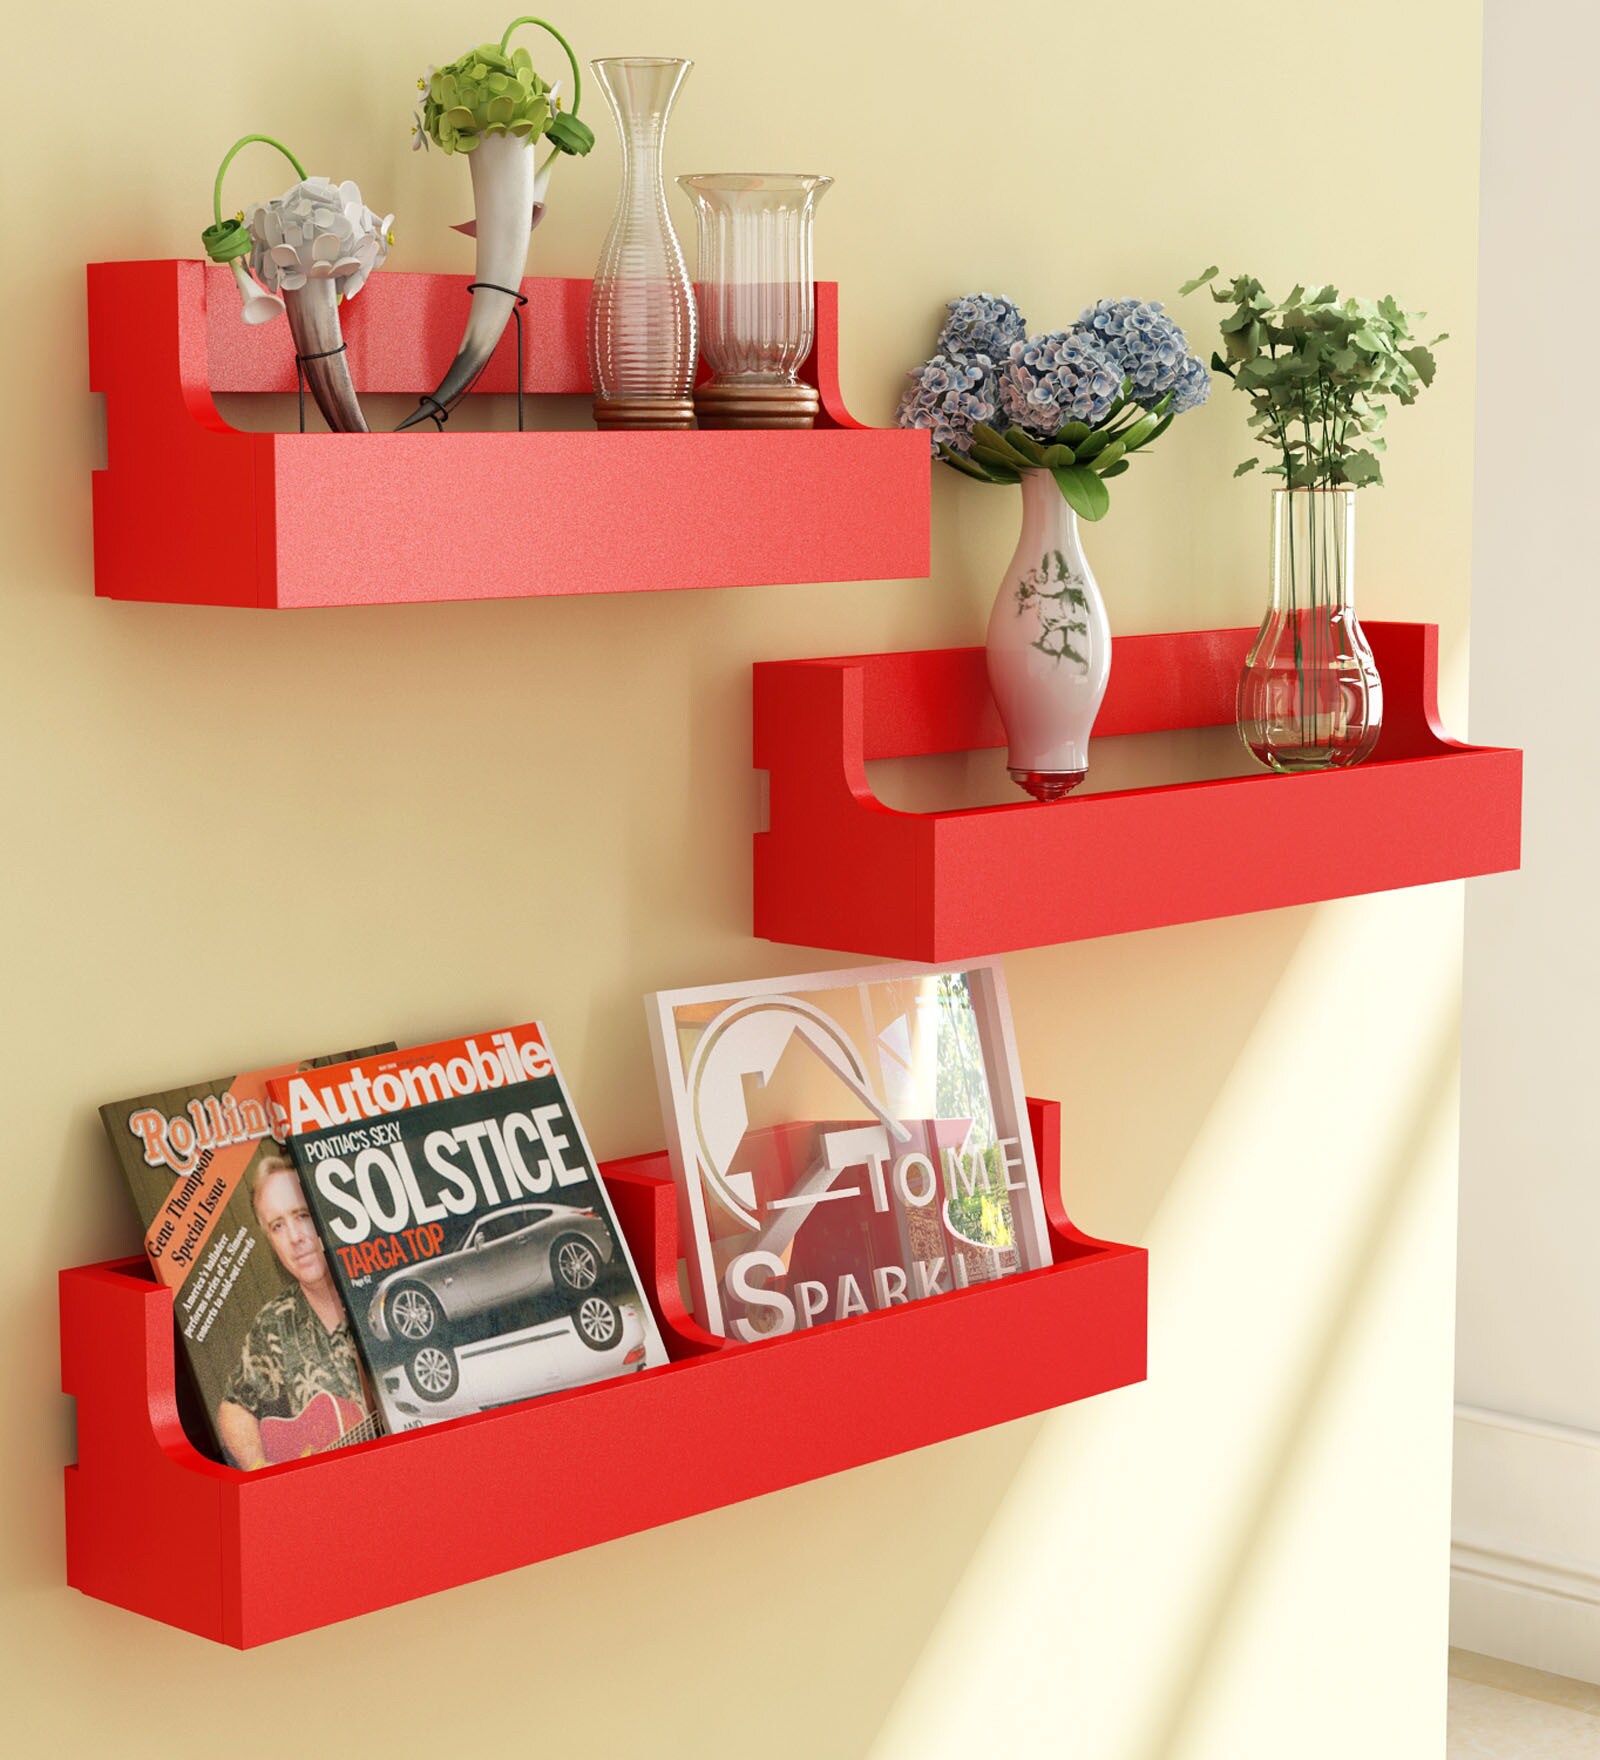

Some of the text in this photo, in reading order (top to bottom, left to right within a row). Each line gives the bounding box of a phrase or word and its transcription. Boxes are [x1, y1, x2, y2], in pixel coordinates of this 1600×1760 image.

[288, 1032, 552, 1136] Automobile
[304, 1121, 403, 1163] PONTIAC'S SEXY
[315, 1104, 588, 1244] SOLSTICE
[148, 1149, 214, 1258] Gene Thompson
[171, 1177, 227, 1267] Special Issue
[336, 1222, 445, 1278] TARGA TOP
[182, 1233, 229, 1313] America's balladeer
[184, 1300, 208, 1339] performs
[204, 1276, 221, 1301] series
[217, 1263, 225, 1277] of
[226, 1226, 248, 1256] Simons
[196, 1307, 218, 1342] concerts
[214, 1298, 224, 1309] to
[237, 1237, 255, 1267] crowds
